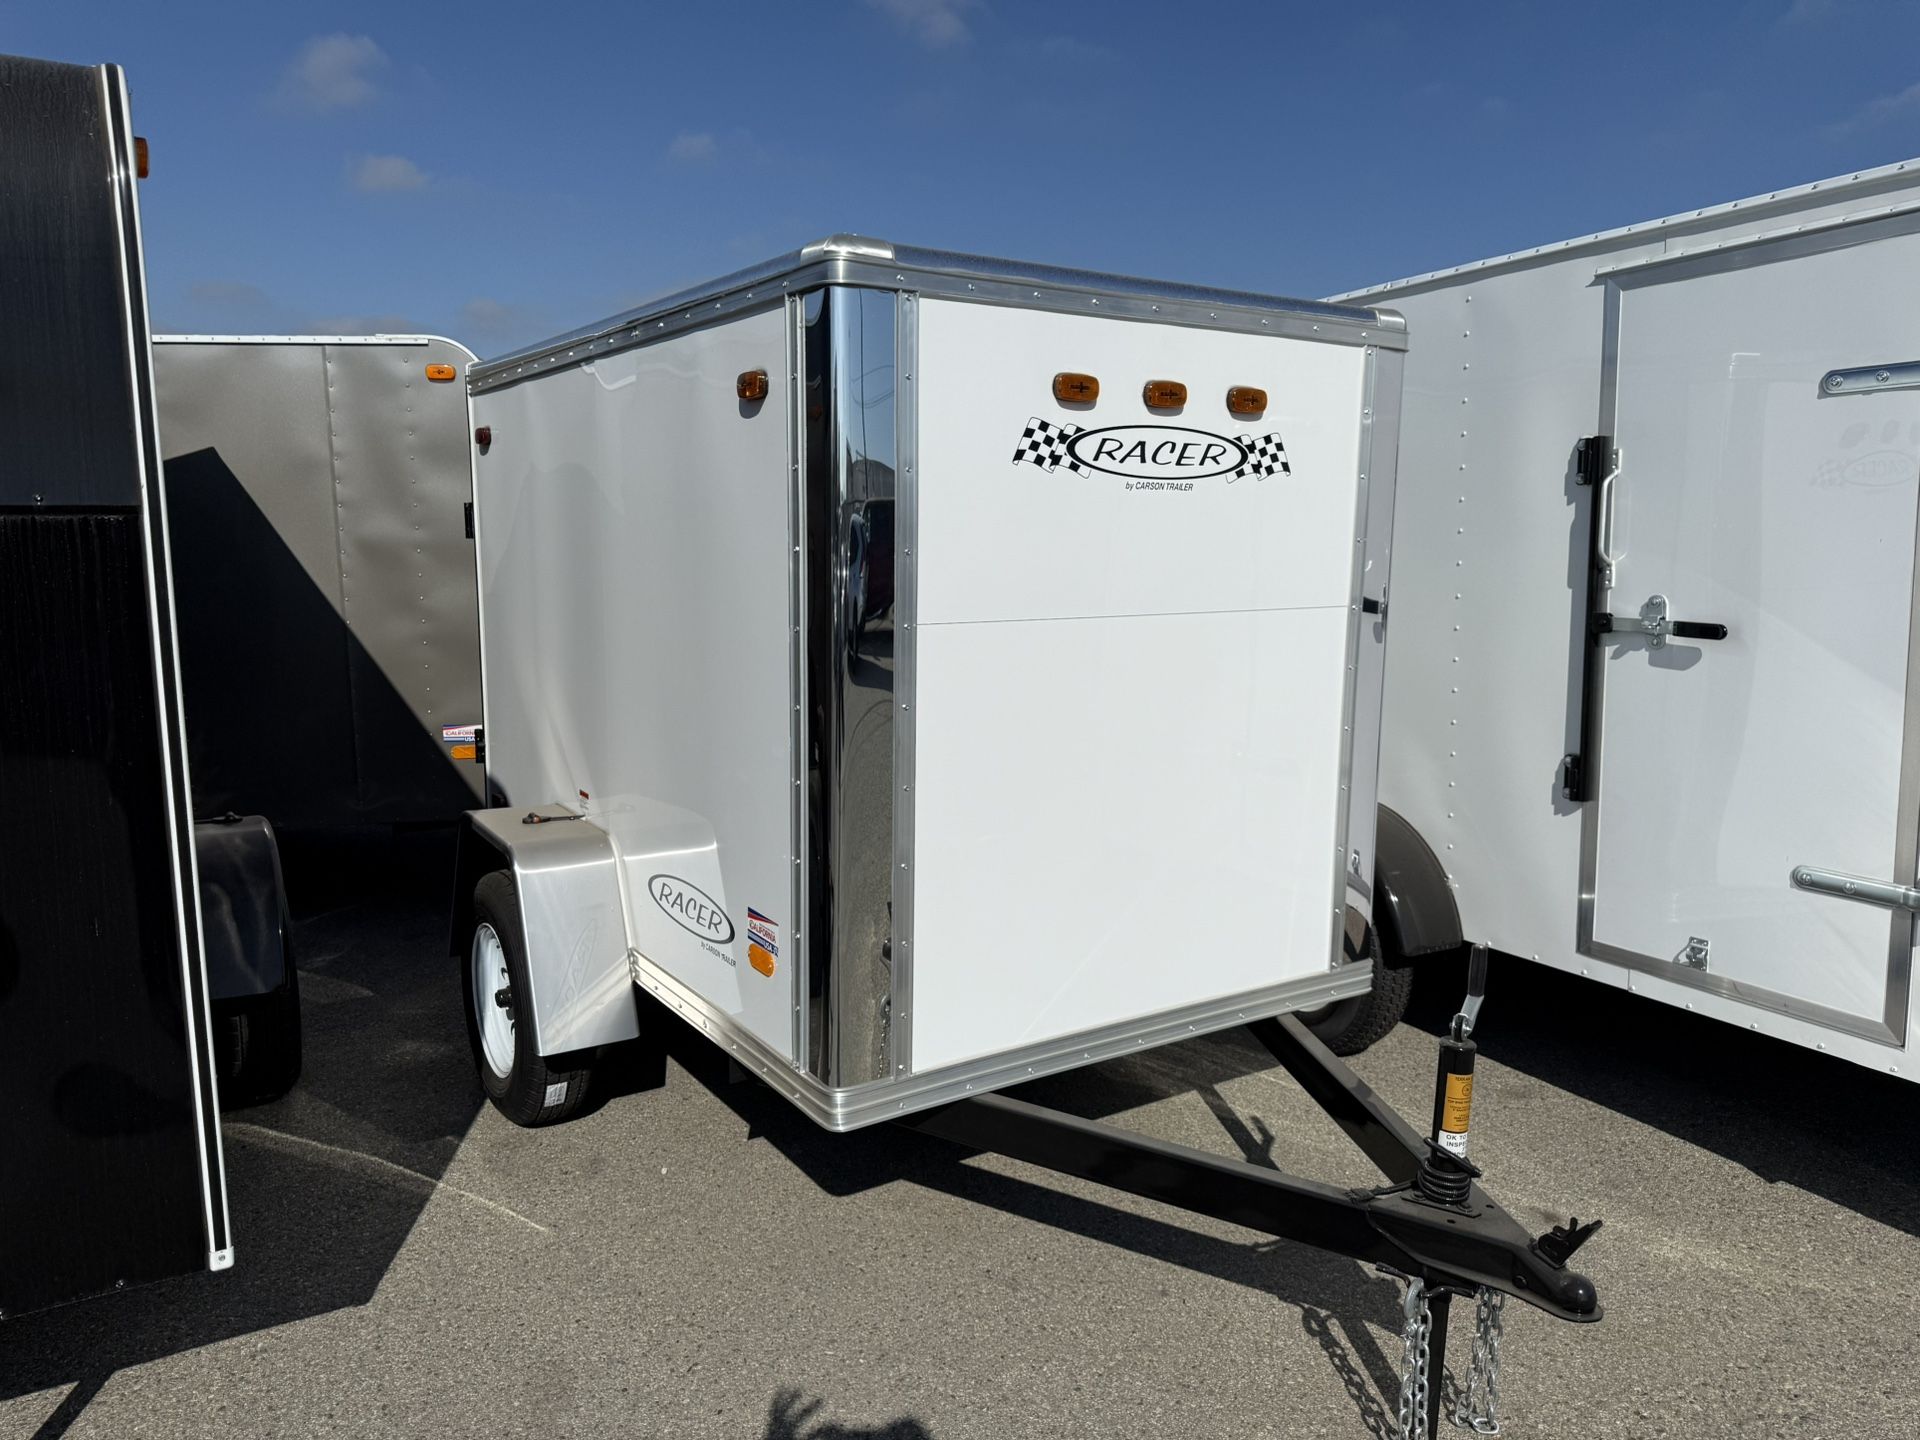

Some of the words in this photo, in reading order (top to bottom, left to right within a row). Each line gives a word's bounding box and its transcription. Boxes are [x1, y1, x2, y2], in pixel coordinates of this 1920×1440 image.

[1092, 437, 1227, 467] RACER
[1125, 481, 1134, 491] by
[1135, 481, 1165, 491] CARSON
[1165, 482, 1194, 491] TRAILER
[659, 882, 722, 934] RACER
[749, 920, 776, 943] CALIFORNIA
[705, 943, 721, 958] CARSON
[721, 953, 737, 968] TRAILER
